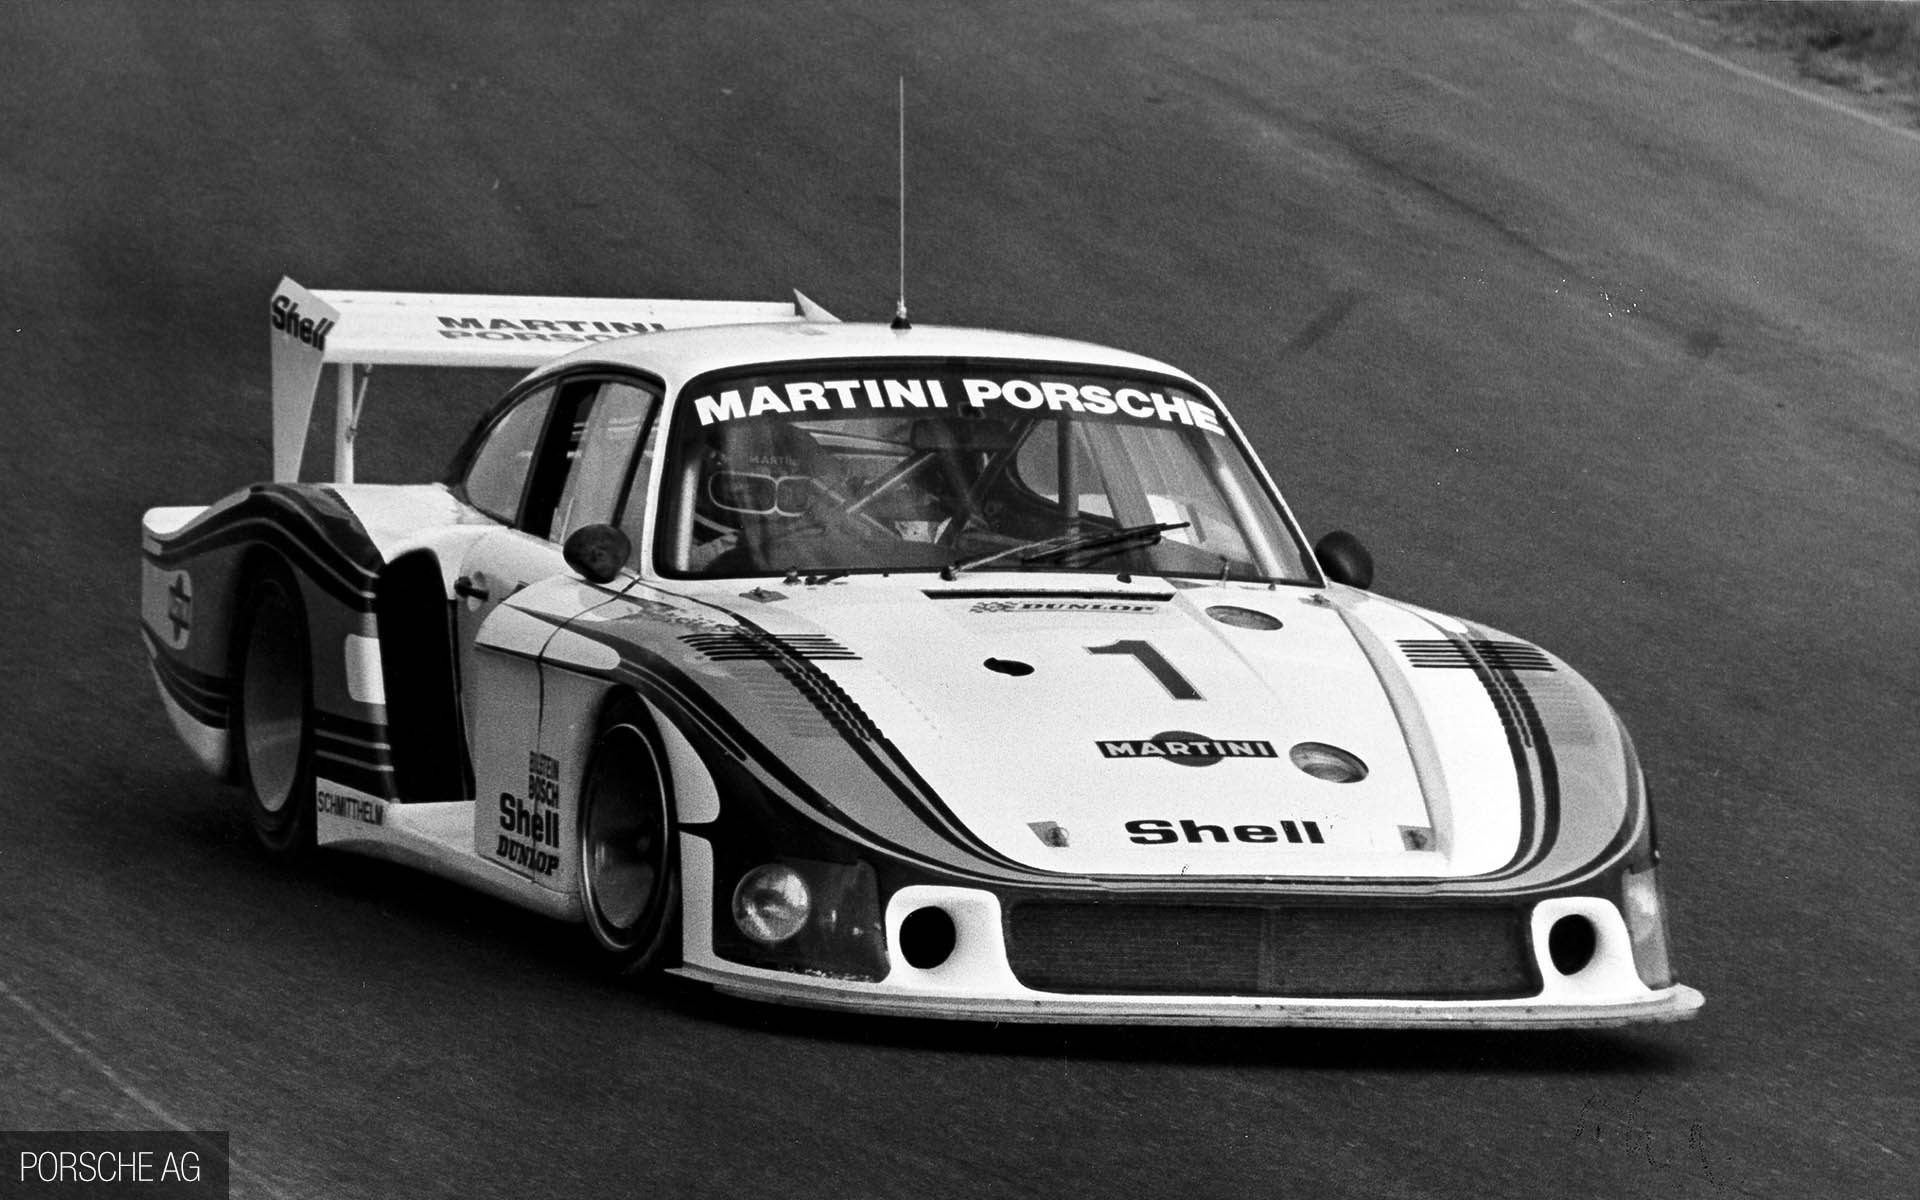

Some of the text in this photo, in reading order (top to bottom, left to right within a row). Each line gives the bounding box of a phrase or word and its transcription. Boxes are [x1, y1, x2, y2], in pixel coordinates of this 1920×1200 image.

[271, 295, 334, 351] Shell
[437, 316, 665, 333] MARTINI
[438, 330, 618, 342] PORSC
[694, 379, 1226, 437] MARTINI PORSCHE
[1021, 602, 1155, 612] DUNLOP
[1084, 640, 1206, 701] 1
[1106, 741, 1271, 758] MARTINI
[500, 792, 559, 848] Shell
[1124, 820, 1326, 844] Shell
[496, 834, 559, 876] DUNLOP
